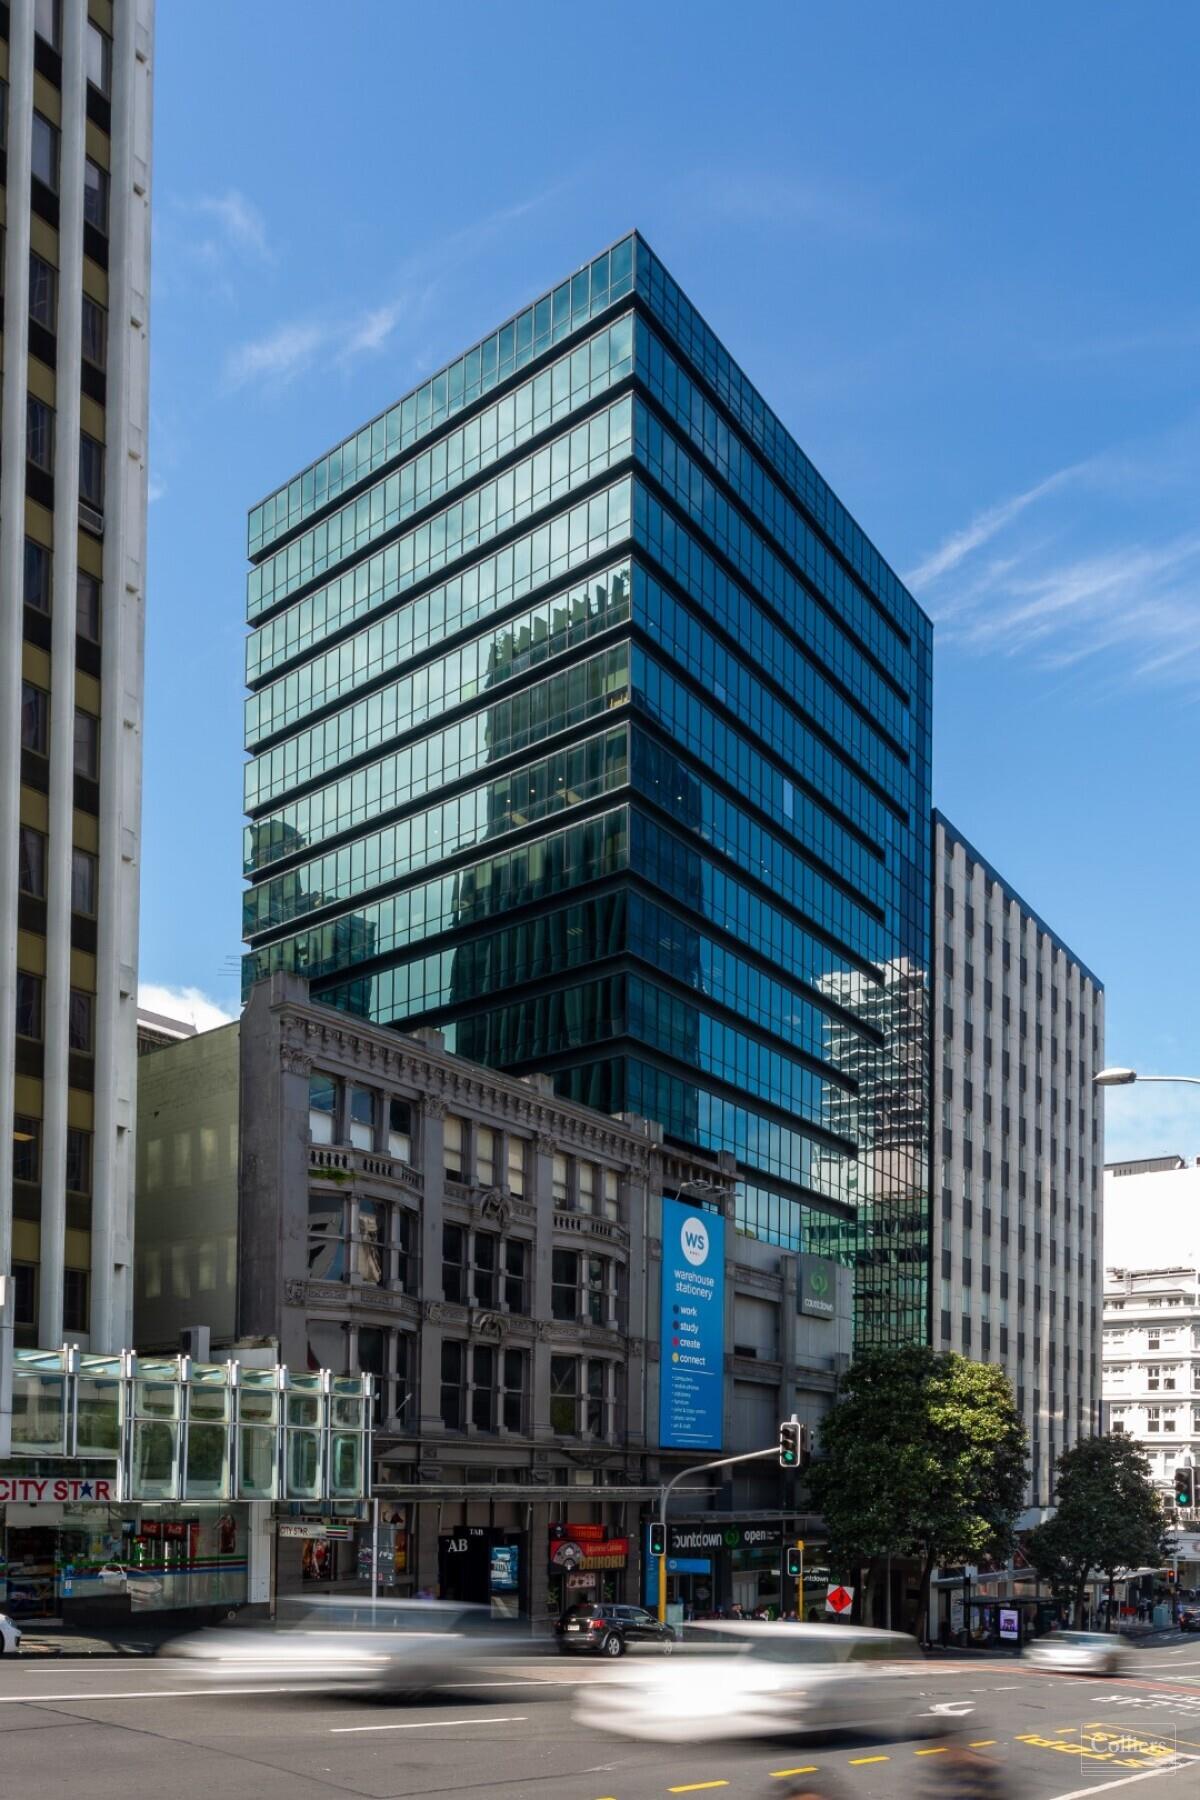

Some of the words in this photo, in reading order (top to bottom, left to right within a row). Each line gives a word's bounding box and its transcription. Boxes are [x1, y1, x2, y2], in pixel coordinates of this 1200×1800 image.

[685, 1231, 705, 1250] WS
[674, 1269, 715, 1287] warehouse
[675, 1281, 713, 1301] stationery
[680, 1306, 698, 1317] work
[680, 1322, 699, 1335] study
[680, 1339, 701, 1349] create
[680, 1354, 706, 1366] connect
[0, 1479, 48, 1501] CITY
[280, 1526, 292, 1535] CITY
[469, 1528, 484, 1536] TAB
[744, 1530, 766, 1544] open
[445, 1538, 469, 1553] AB
